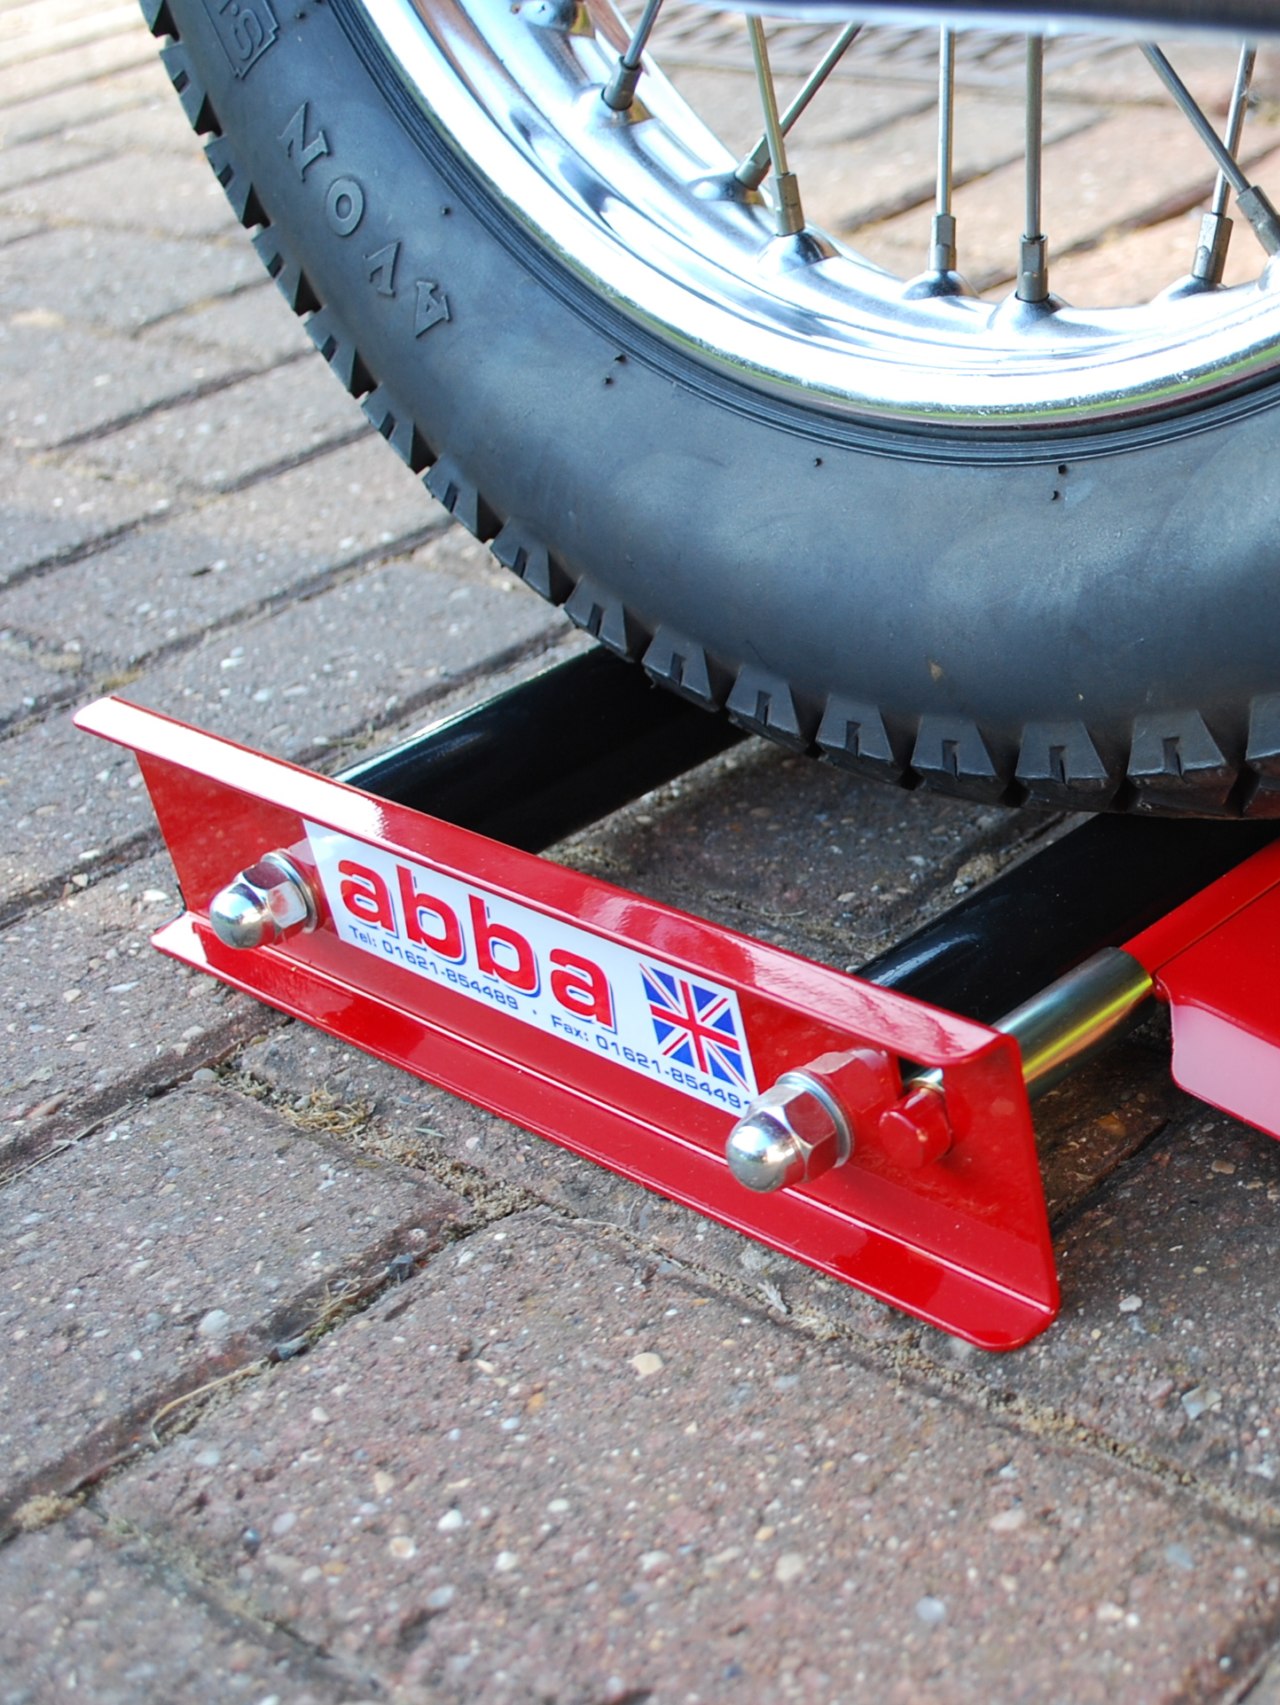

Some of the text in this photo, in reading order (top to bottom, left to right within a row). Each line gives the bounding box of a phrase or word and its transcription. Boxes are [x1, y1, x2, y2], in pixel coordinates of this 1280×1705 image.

[278, 101, 452, 338] AVON
[338, 858, 618, 1034] abba
[348, 925, 378, 948] Tel:
[381, 937, 518, 1010] 01621-854489
[551, 1014, 590, 1043] Fax:
